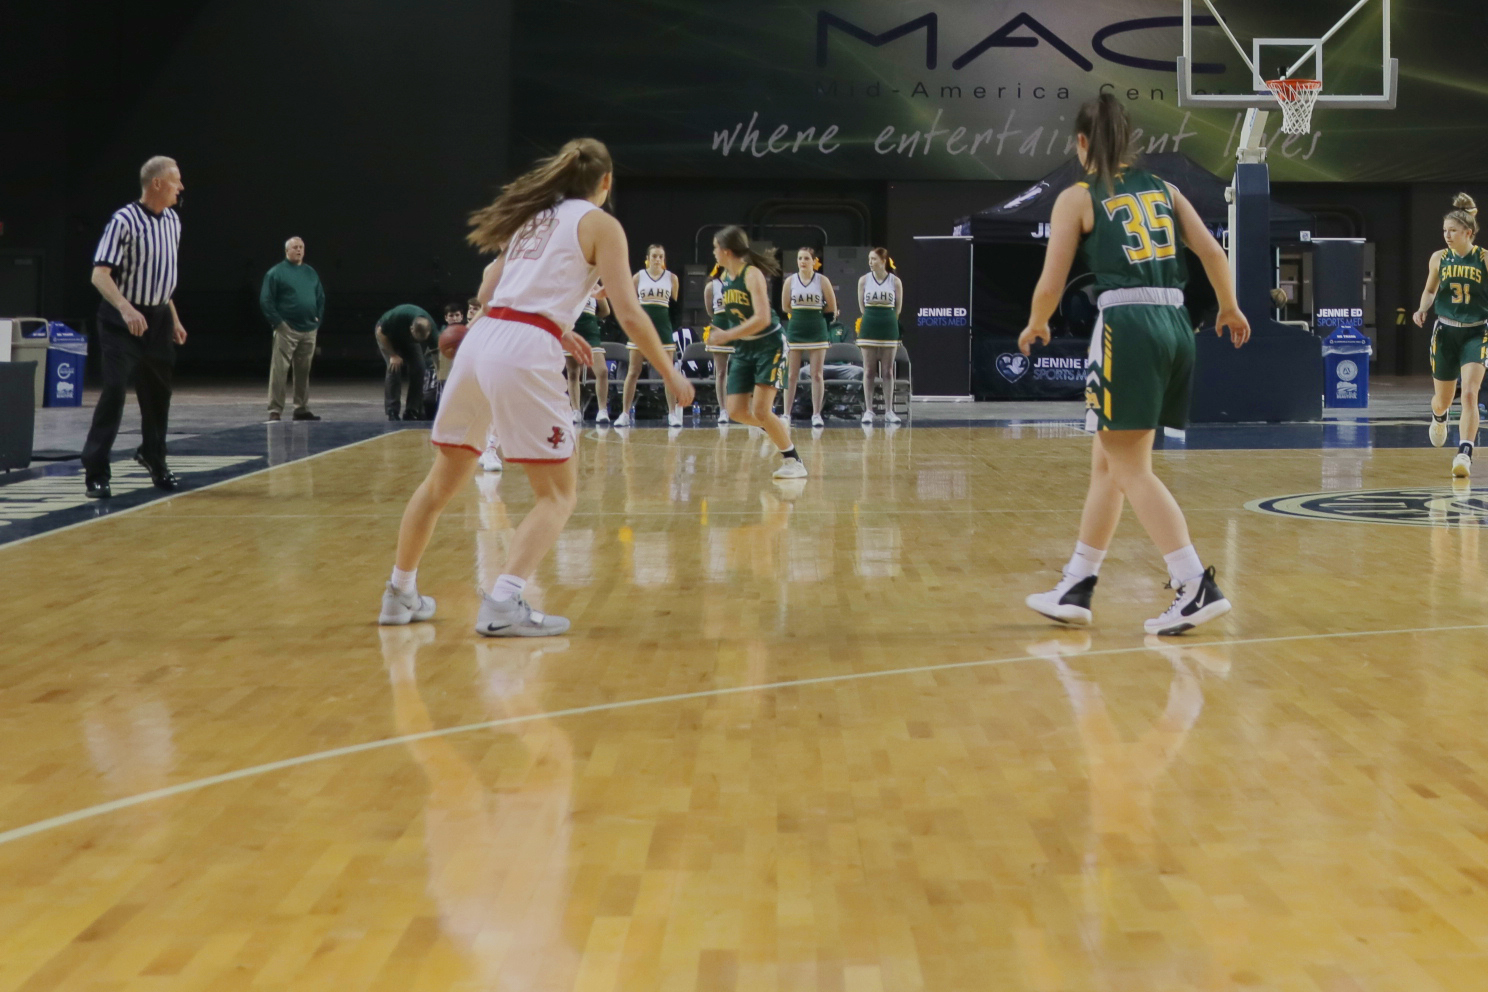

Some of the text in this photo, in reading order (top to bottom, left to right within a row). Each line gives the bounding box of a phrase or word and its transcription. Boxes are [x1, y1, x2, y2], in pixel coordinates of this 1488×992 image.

[816, 10, 1227, 74] MAC
[816, 81, 1071, 101] Mid-America
[711, 110, 840, 158] where
[1223, 112, 1322, 160] lves
[1101, 189, 1176, 265] 35
[1441, 265, 1482, 284] SAINTES
[640, 288, 671, 300] SAHS
[791, 293, 820, 304] SAHS
[865, 291, 894, 302] SAHS
[1449, 282, 1471, 305] 31
[917, 307, 967, 317] JENNIE ED
[1317, 308, 1363, 318] JENNIE ED
[917, 317, 967, 326] SPORTS MED
[1317, 318, 1363, 327] SPORTS MED
[1033, 357, 1081, 369] JENNIE
[1033, 368, 1075, 381] SPORTS
